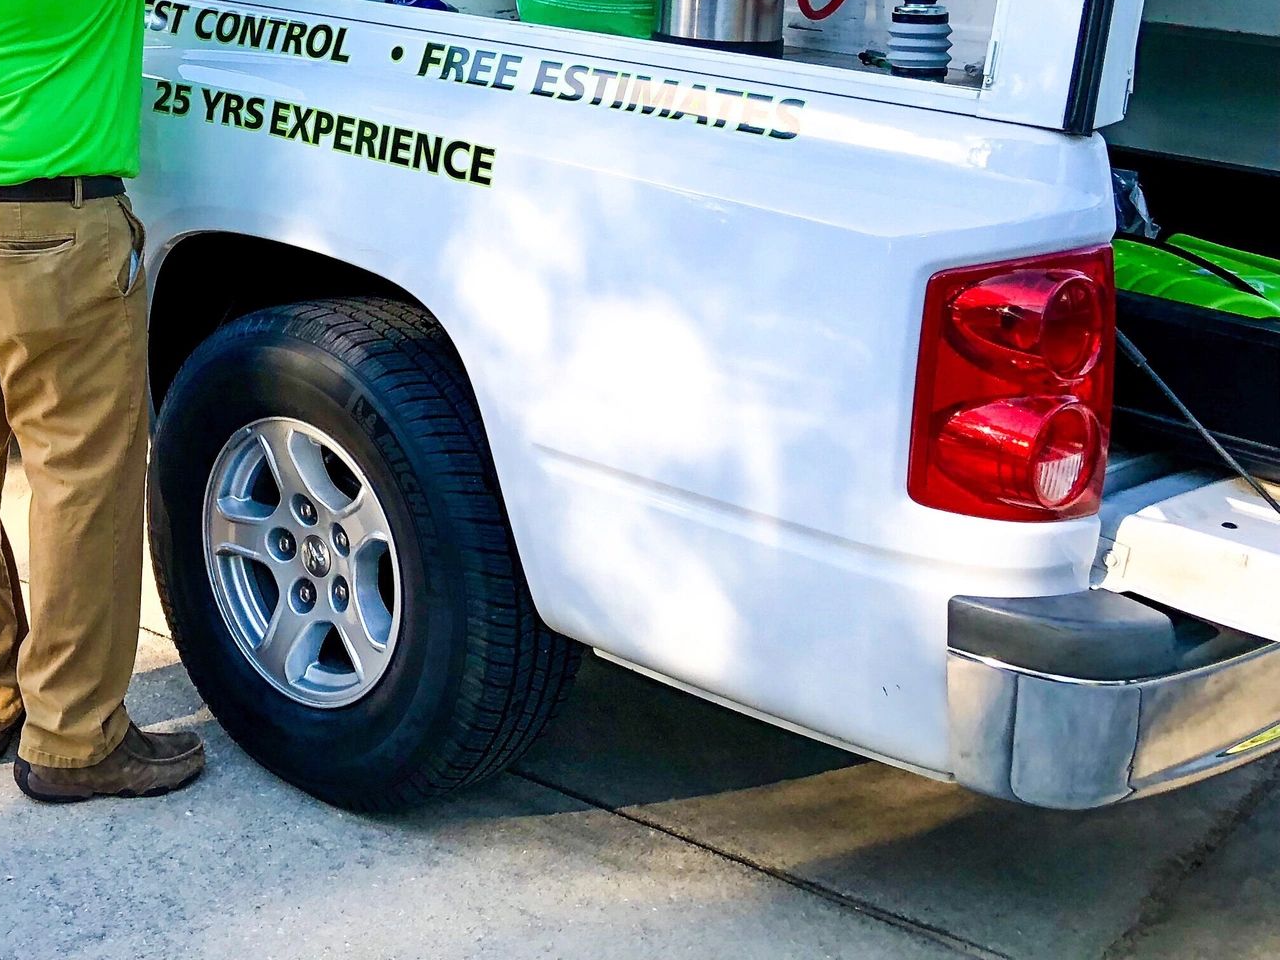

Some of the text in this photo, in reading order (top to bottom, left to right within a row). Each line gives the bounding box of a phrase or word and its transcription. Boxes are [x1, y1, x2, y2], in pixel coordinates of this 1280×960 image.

[195, 8, 351, 63] CONTROL
[417, 41, 523, 91] FREE
[530, 58, 806, 139] ESTIMATES
[153, 81, 496, 187] 25 YRS EXPERIENCE
